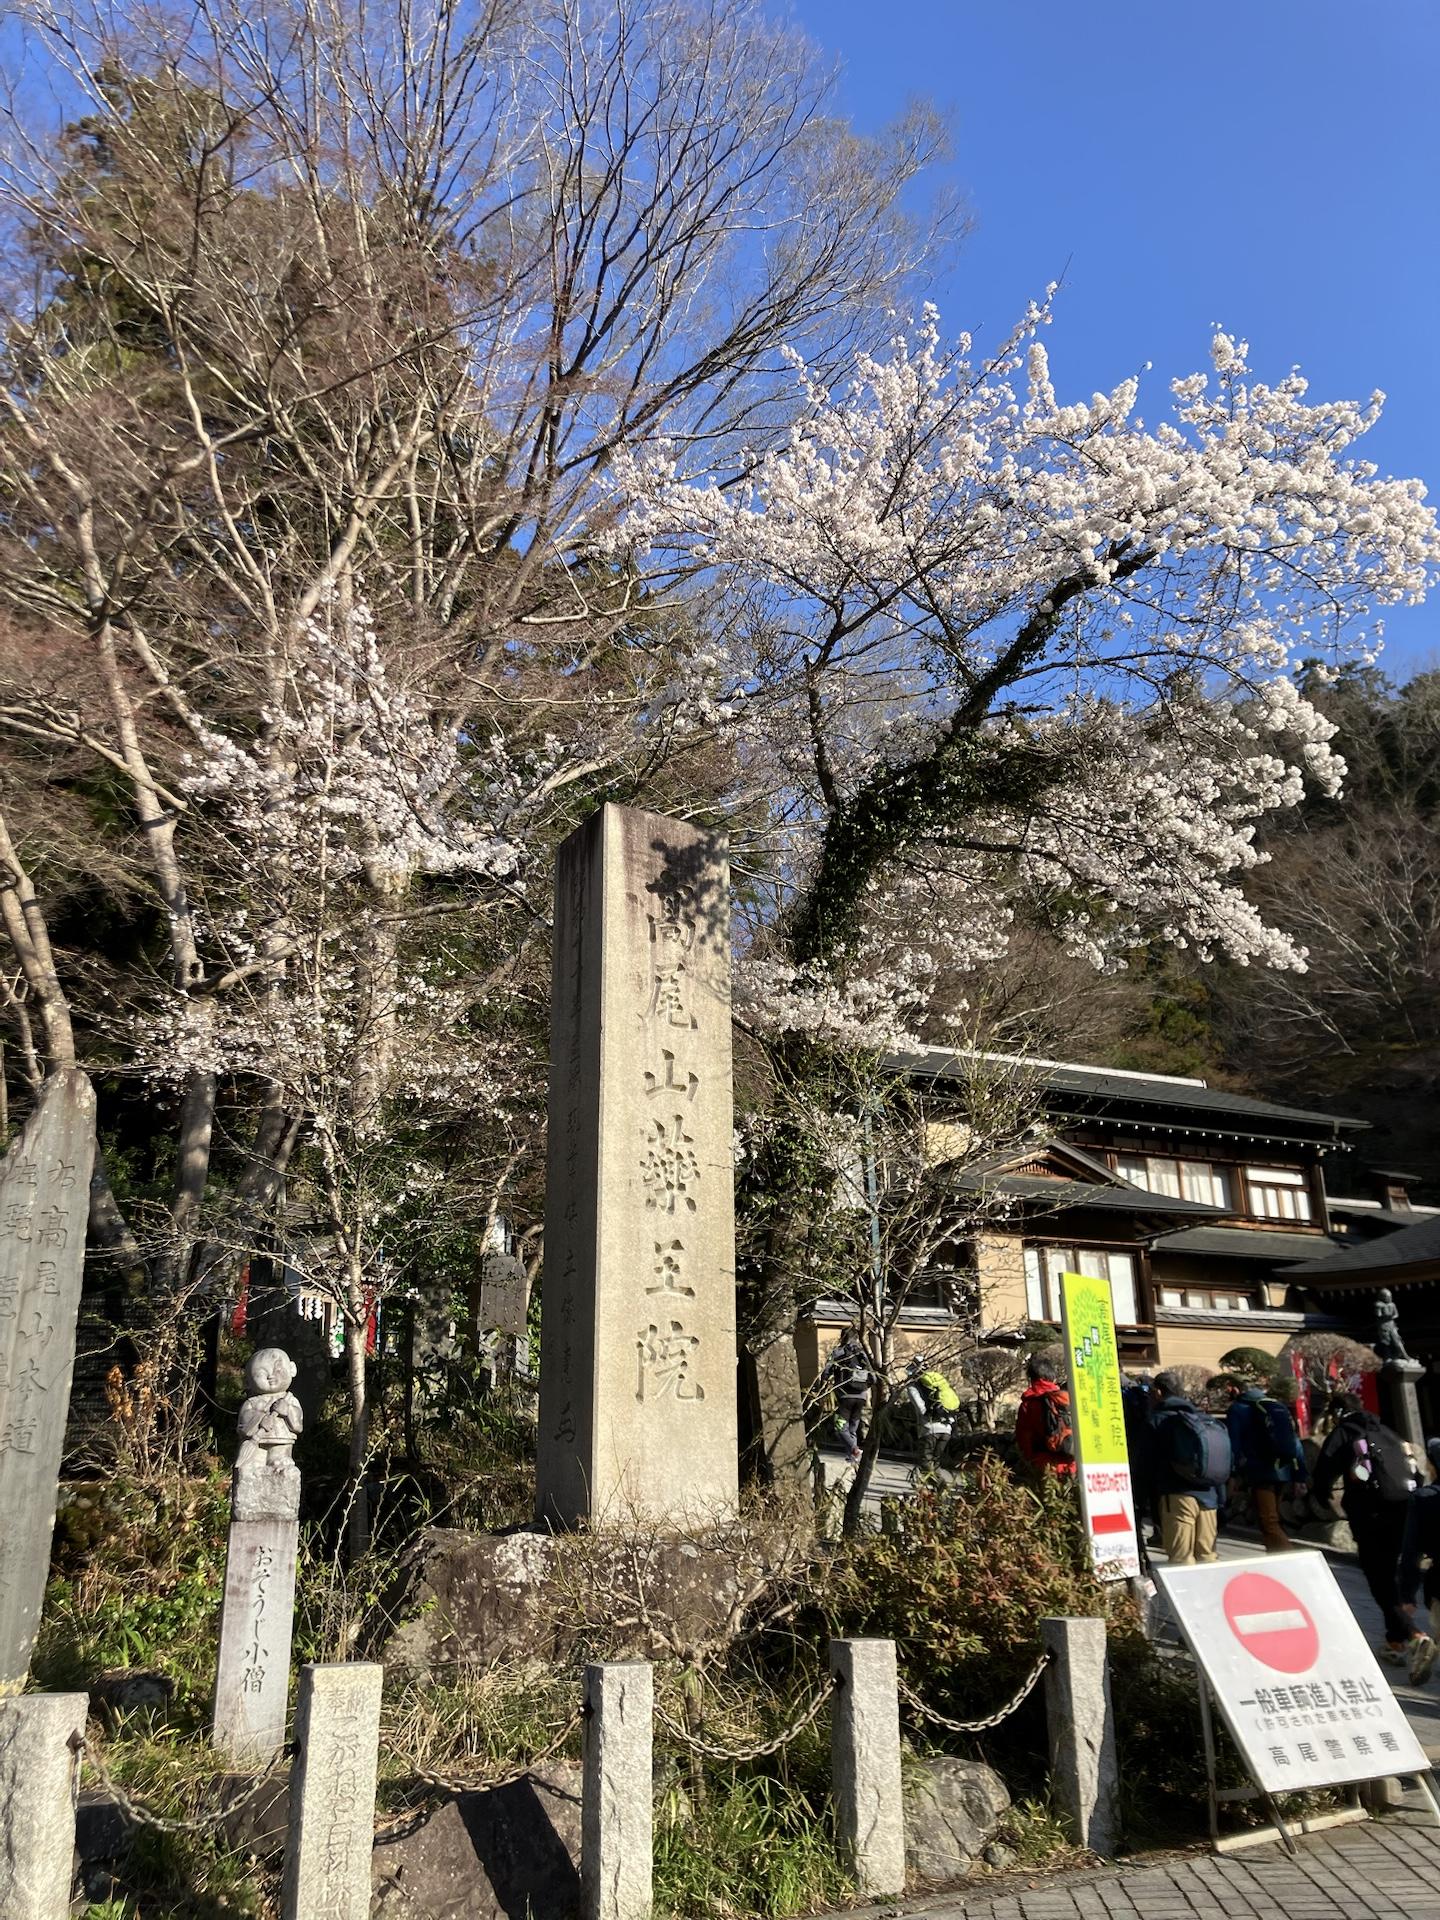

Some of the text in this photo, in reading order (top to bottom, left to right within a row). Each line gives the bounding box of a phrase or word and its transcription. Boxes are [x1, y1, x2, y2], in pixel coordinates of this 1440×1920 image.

[241, 1545, 273, 1694] おそうじ小僧
[1268, 1731, 1400, 1768] 高尾警察署
